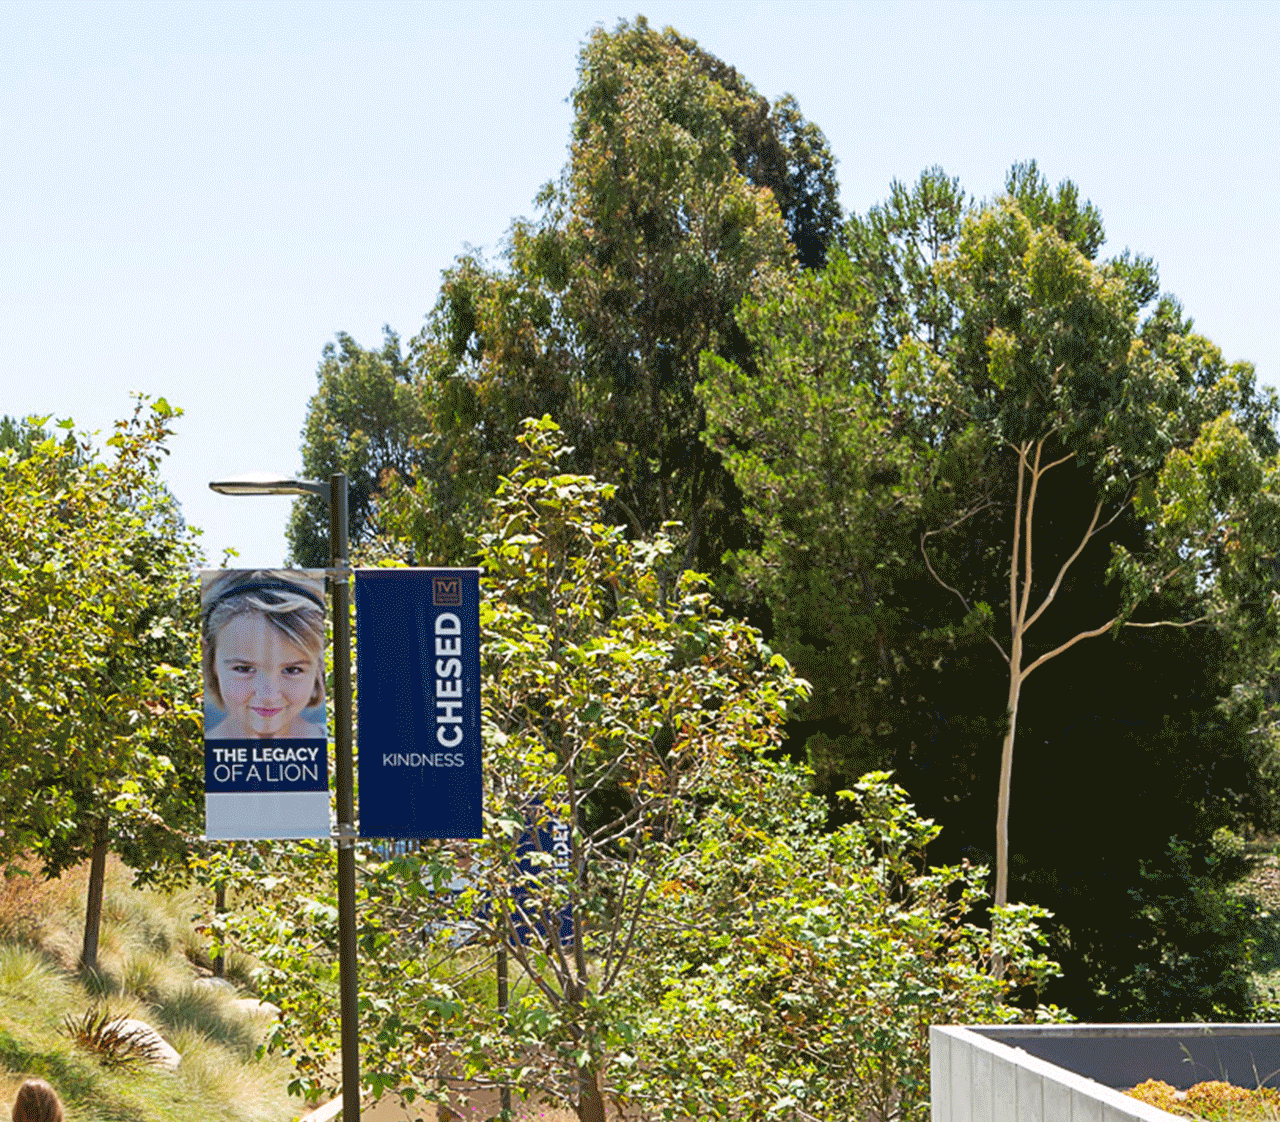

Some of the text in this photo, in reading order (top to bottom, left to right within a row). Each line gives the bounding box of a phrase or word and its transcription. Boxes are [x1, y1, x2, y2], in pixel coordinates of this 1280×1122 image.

[435, 612, 463, 748] CHESED
[212, 747, 319, 762] THE LEGACY
[382, 753, 465, 767] KINDNESS
[213, 763, 319, 783] OF A LION
[552, 817, 570, 884] EDEK
